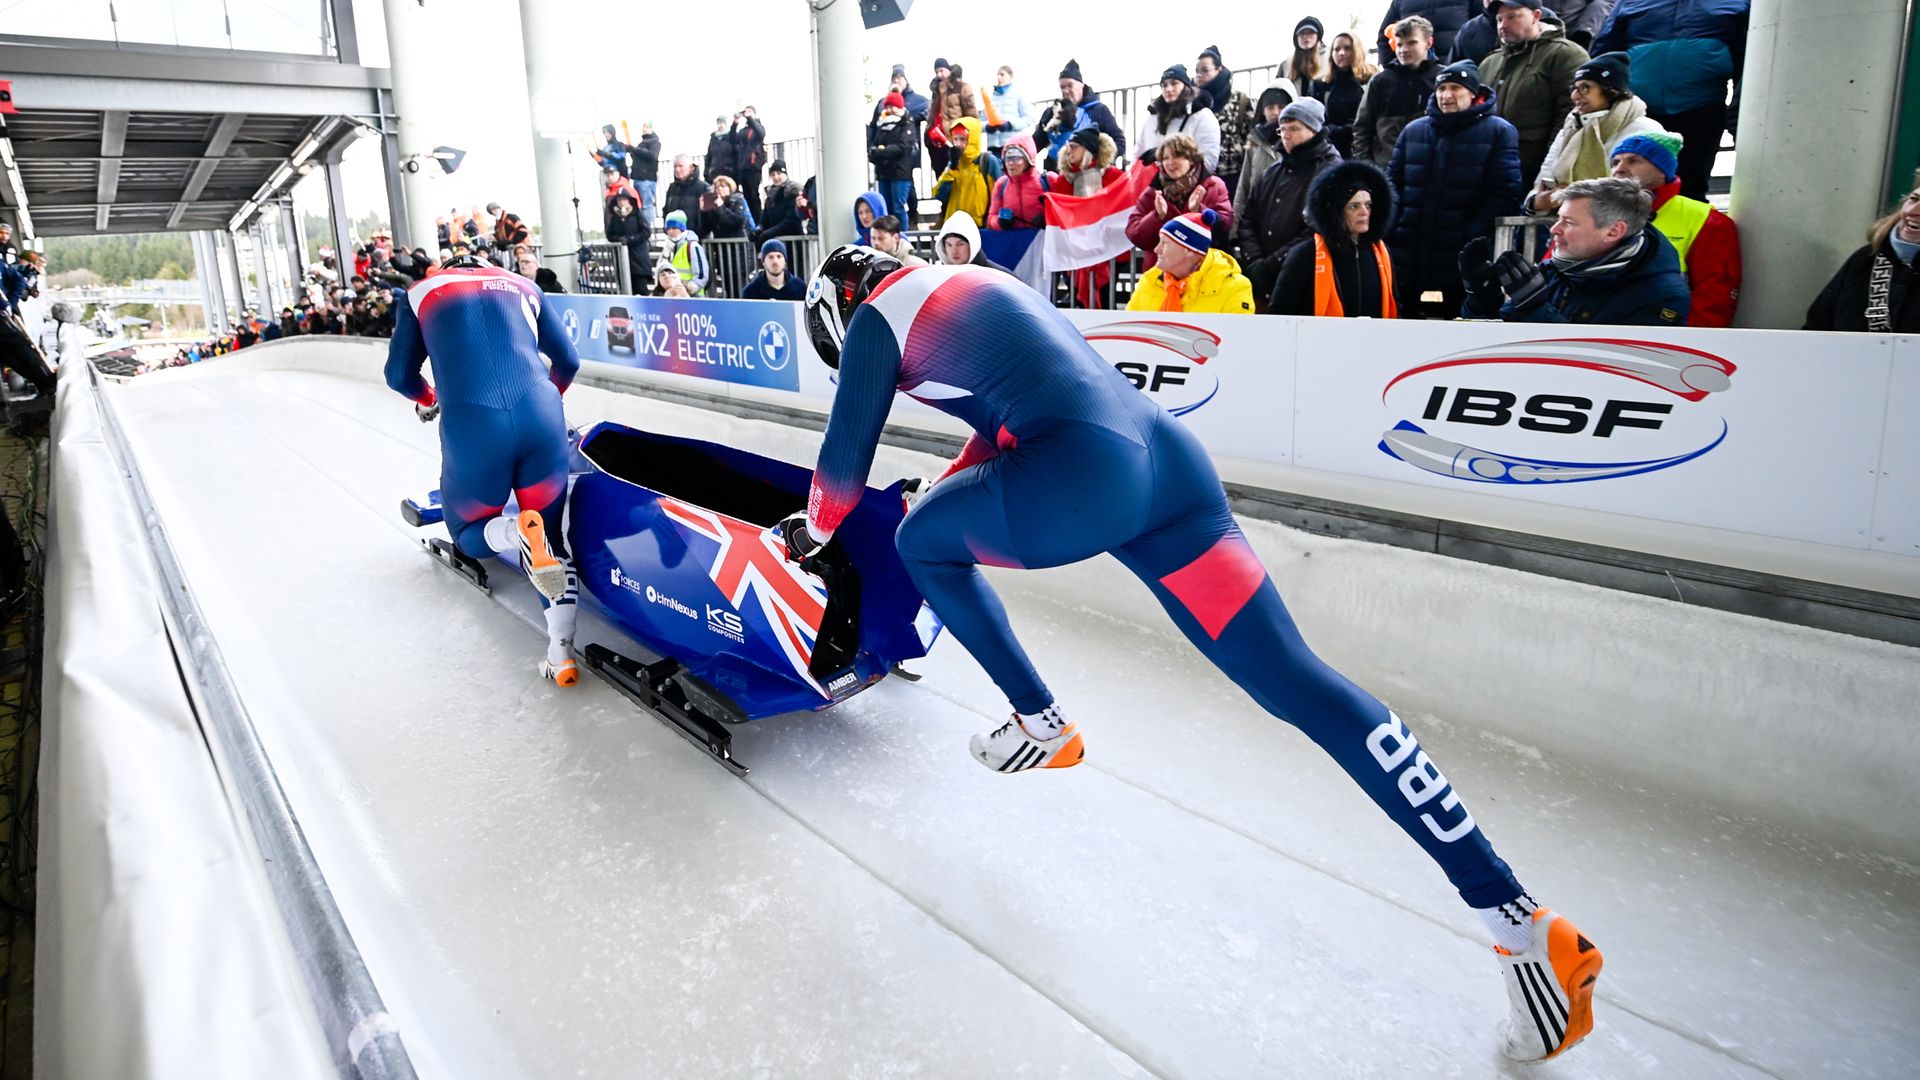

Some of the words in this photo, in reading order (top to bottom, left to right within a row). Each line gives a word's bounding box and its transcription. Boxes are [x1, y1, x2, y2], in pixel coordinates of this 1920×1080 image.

[637, 322, 672, 358] iX2
[674, 312, 718, 339] 100%
[677, 338, 756, 371] ELECTRIC
[1114, 361, 1191, 393] SF
[1422, 386, 1674, 438] IBSF
[620, 574, 641, 591] FORCES
[705, 603, 743, 633] KS
[707, 623, 745, 645] COMPOSITES
[827, 672, 858, 692] AMBER
[1365, 709, 1476, 843] GBR
